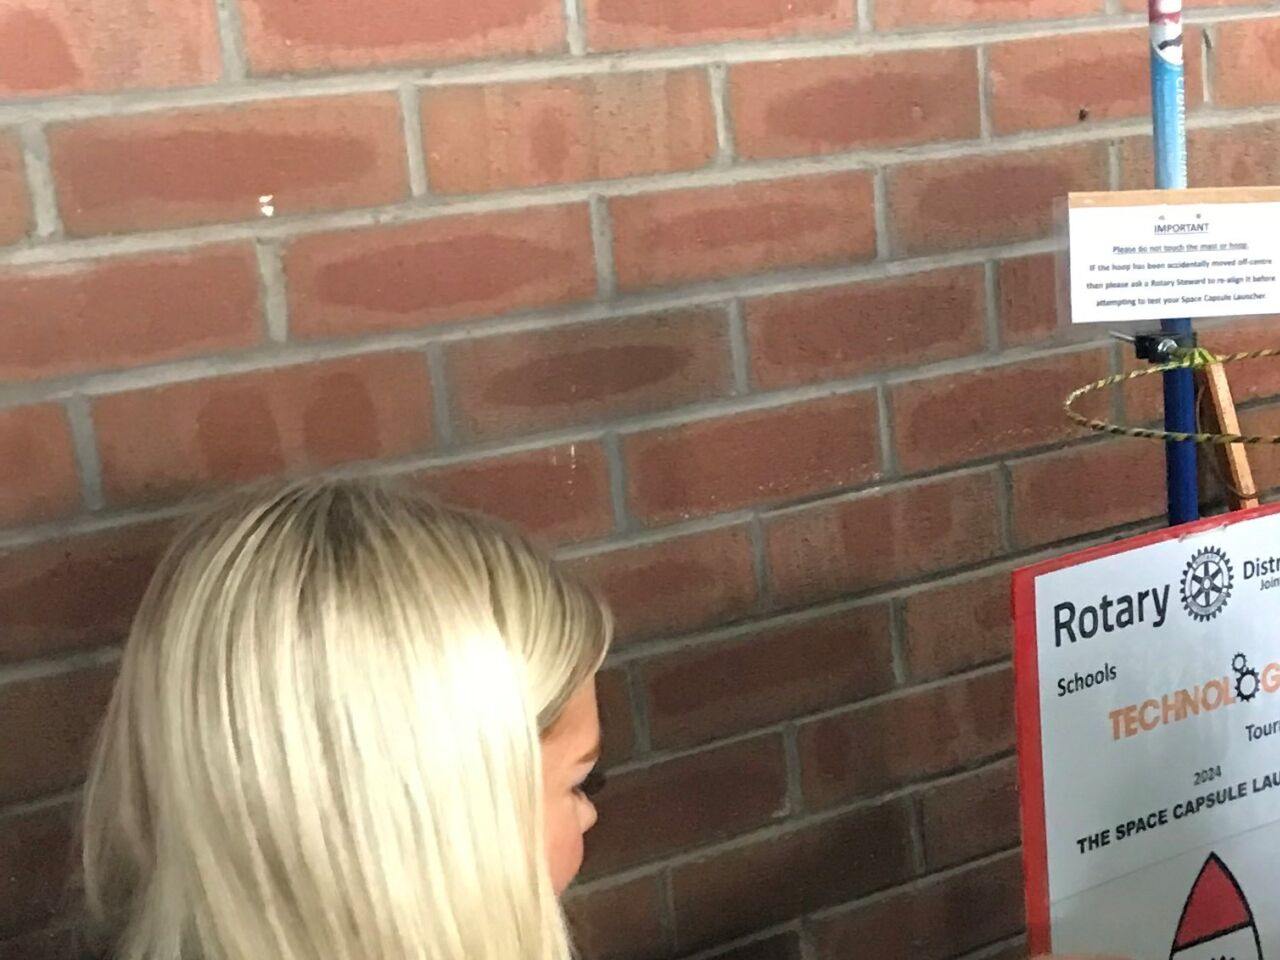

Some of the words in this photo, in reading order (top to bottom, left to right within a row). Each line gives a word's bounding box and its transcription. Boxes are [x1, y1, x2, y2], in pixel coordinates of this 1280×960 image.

[1154, 223, 1210, 235] IMPORTANT
[1112, 245, 1136, 254] Please
[1149, 245, 1162, 253] not
[1163, 244, 1185, 253] touch
[1200, 242, 1218, 250] mast
[1097, 264, 1110, 272] the
[1111, 263, 1131, 272] hoop
[1132, 262, 1146, 270] has
[1147, 262, 1166, 270] been
[1167, 260, 1210, 269] accidentally
[1211, 259, 1236, 267] moved
[1238, 258, 1273, 266] off-centre
[1086, 282, 1104, 290] then
[1105, 280, 1129, 291] please
[1130, 279, 1143, 288] ask
[1150, 279, 1175, 288] Rotary
[1176, 277, 1207, 287] Steward
[1207, 277, 1216, 285] to
[1216, 275, 1244, 286] re-align
[1252, 274, 1276, 283] before
[1096, 298, 1136, 308] attempting
[1137, 297, 1146, 306] to
[1147, 297, 1162, 306] test
[1163, 296, 1180, 306] your
[1181, 295, 1203, 305] Space
[1203, 294, 1232, 303] Capsule
[1053, 584, 1171, 648] Rotary
[1056, 662, 1118, 697] Schools
[1193, 764, 1223, 787] 2024
[1076, 829, 1111, 854] THE
[1115, 808, 1169, 841] SPACE
[1173, 782, 1248, 820] CAPSULE
